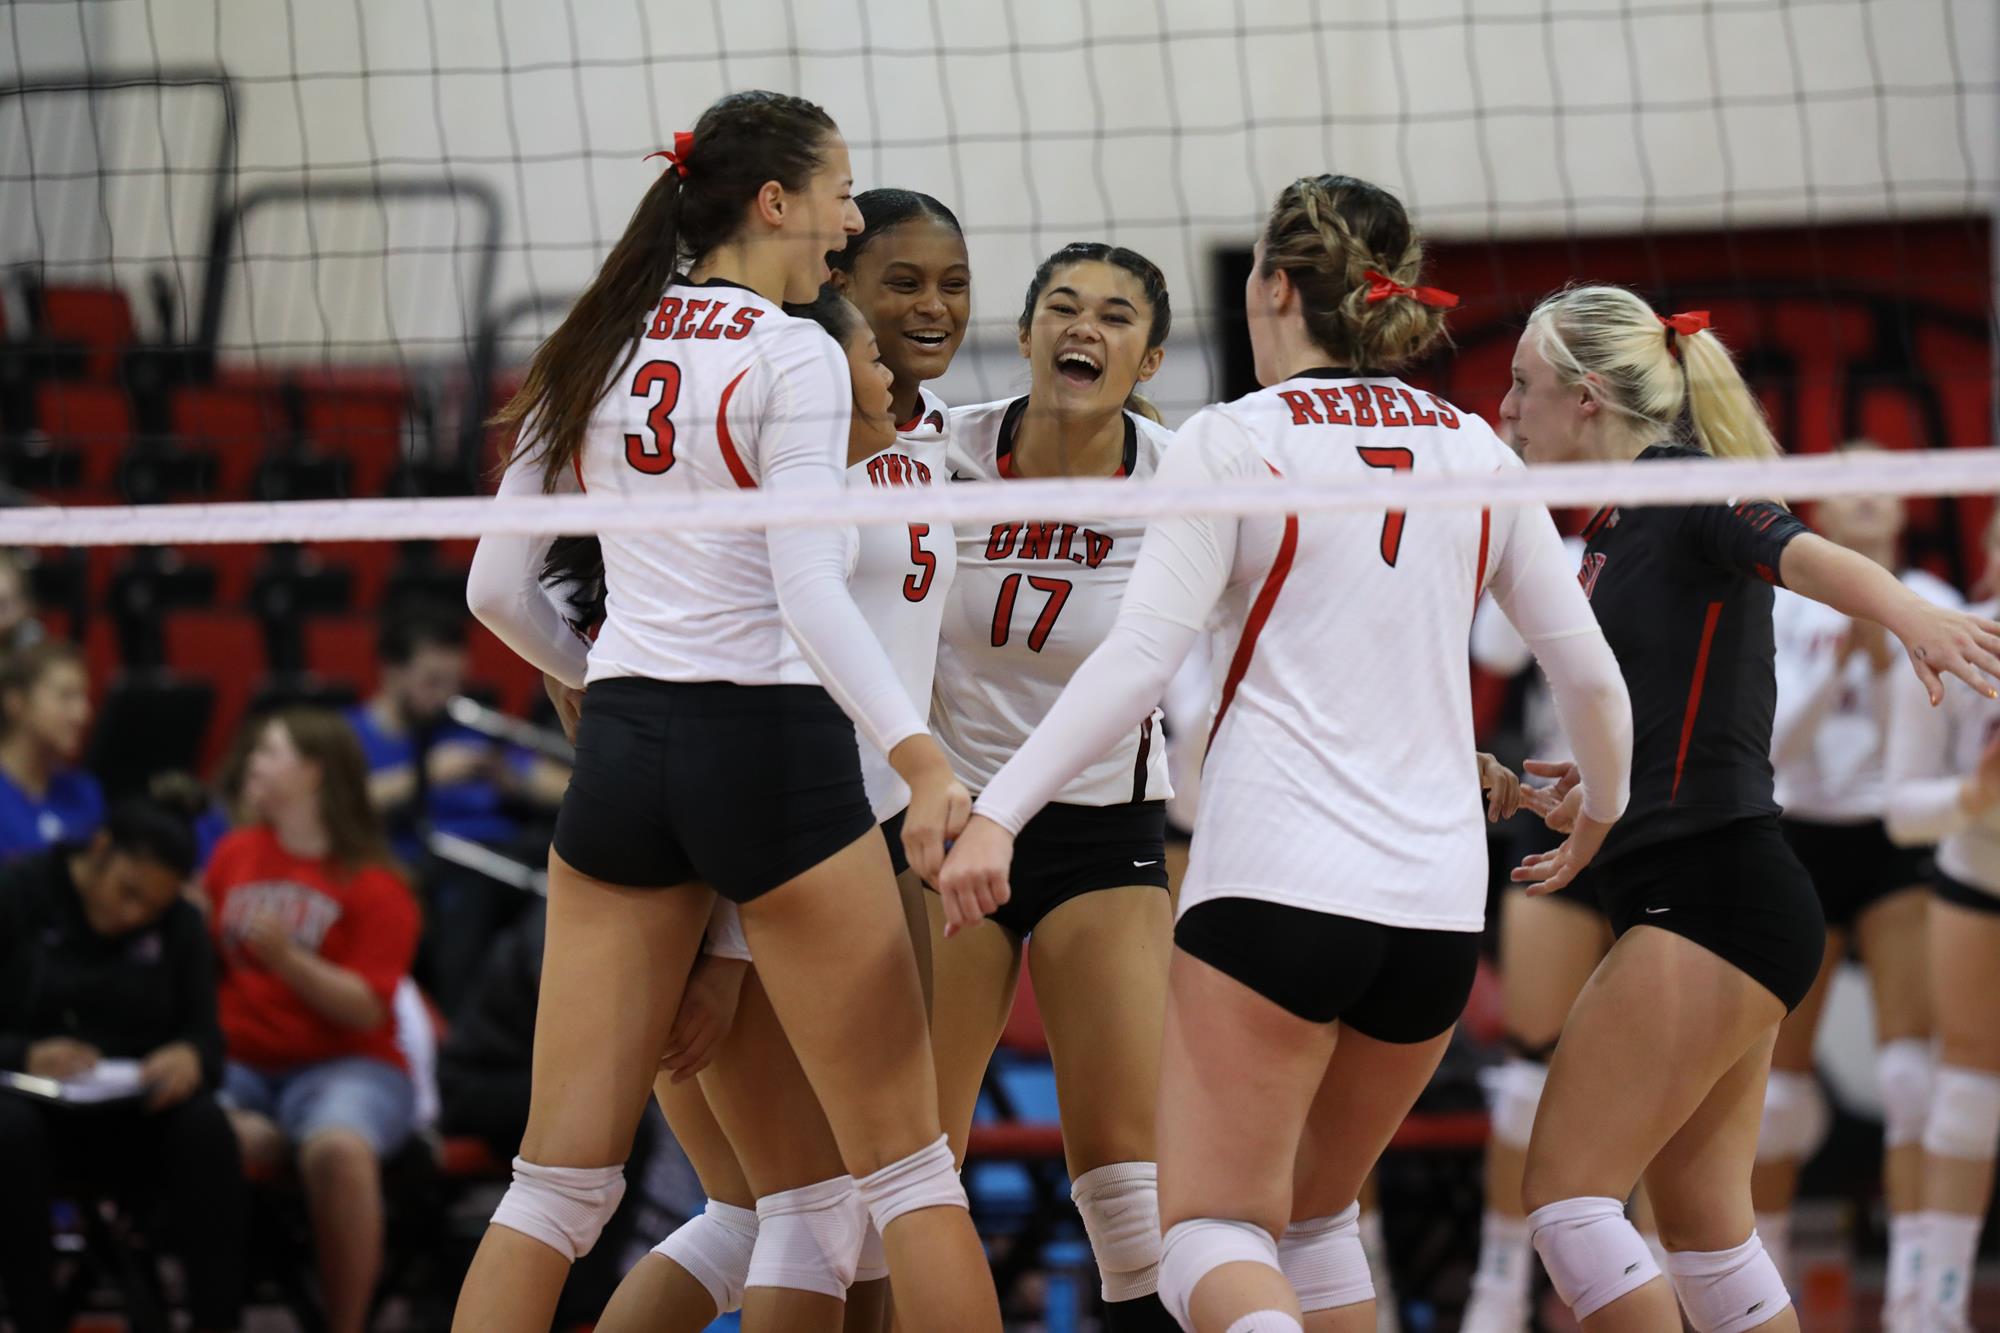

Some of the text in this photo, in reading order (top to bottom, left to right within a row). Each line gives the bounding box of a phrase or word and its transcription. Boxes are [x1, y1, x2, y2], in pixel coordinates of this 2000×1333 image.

[641, 296, 765, 340] BELS
[624, 359, 681, 475] 3
[1277, 384, 1460, 430] REBELS
[984, 519, 1114, 569] UNLV
[1356, 446, 1414, 568] 7
[903, 521, 936, 602] 5
[990, 573, 1073, 653] 17
